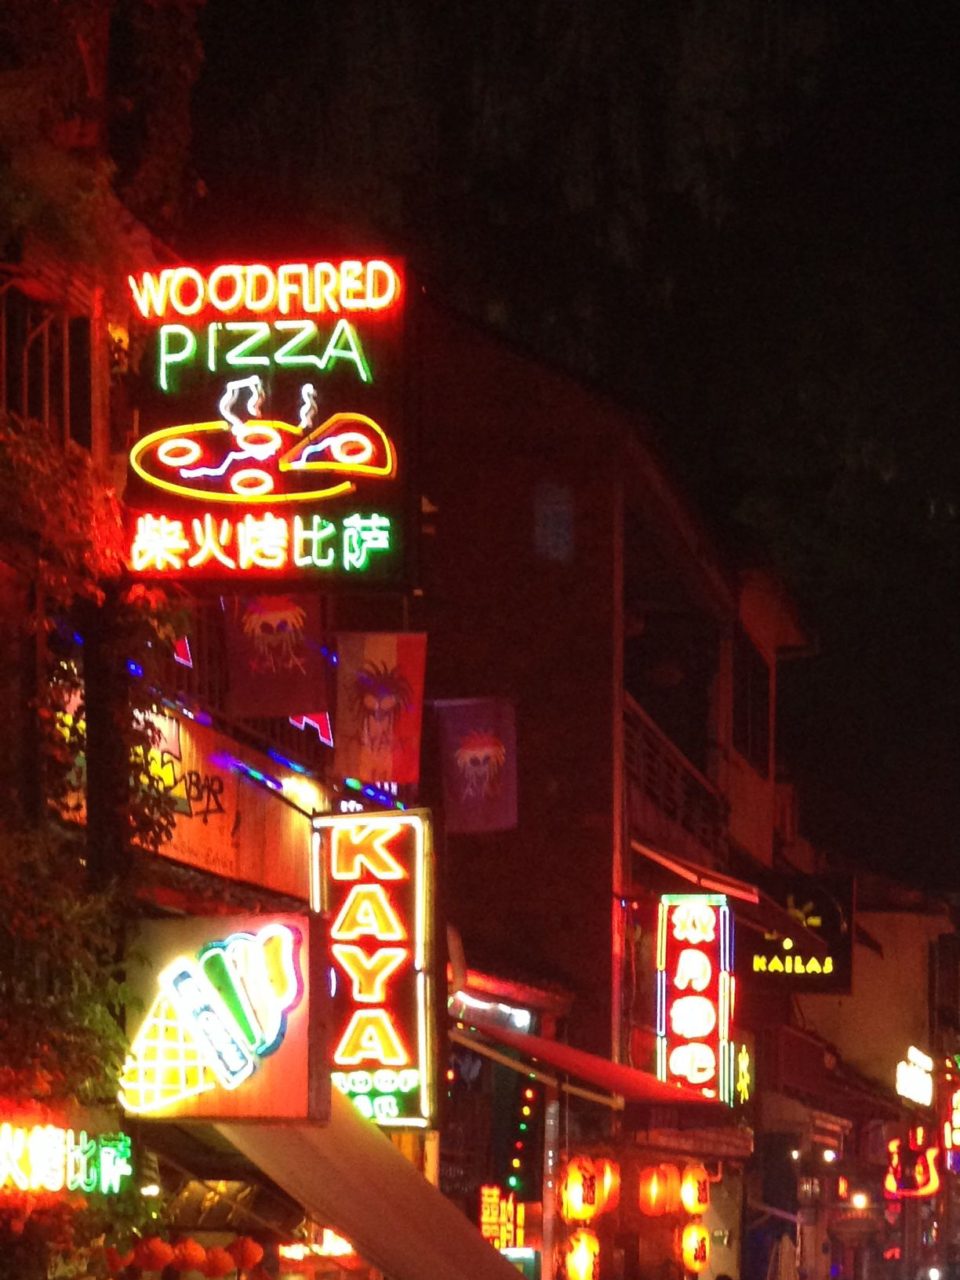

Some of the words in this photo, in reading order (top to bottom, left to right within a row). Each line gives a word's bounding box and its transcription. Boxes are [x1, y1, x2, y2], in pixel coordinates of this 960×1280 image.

[129, 260, 399, 317] WOODFIRED
[158, 319, 371, 391] PIZZA
[131, 512, 392, 571] 柴火烤比萨
[330, 824, 410, 1067] KAYA
[753, 955, 833, 975] KAILAS
